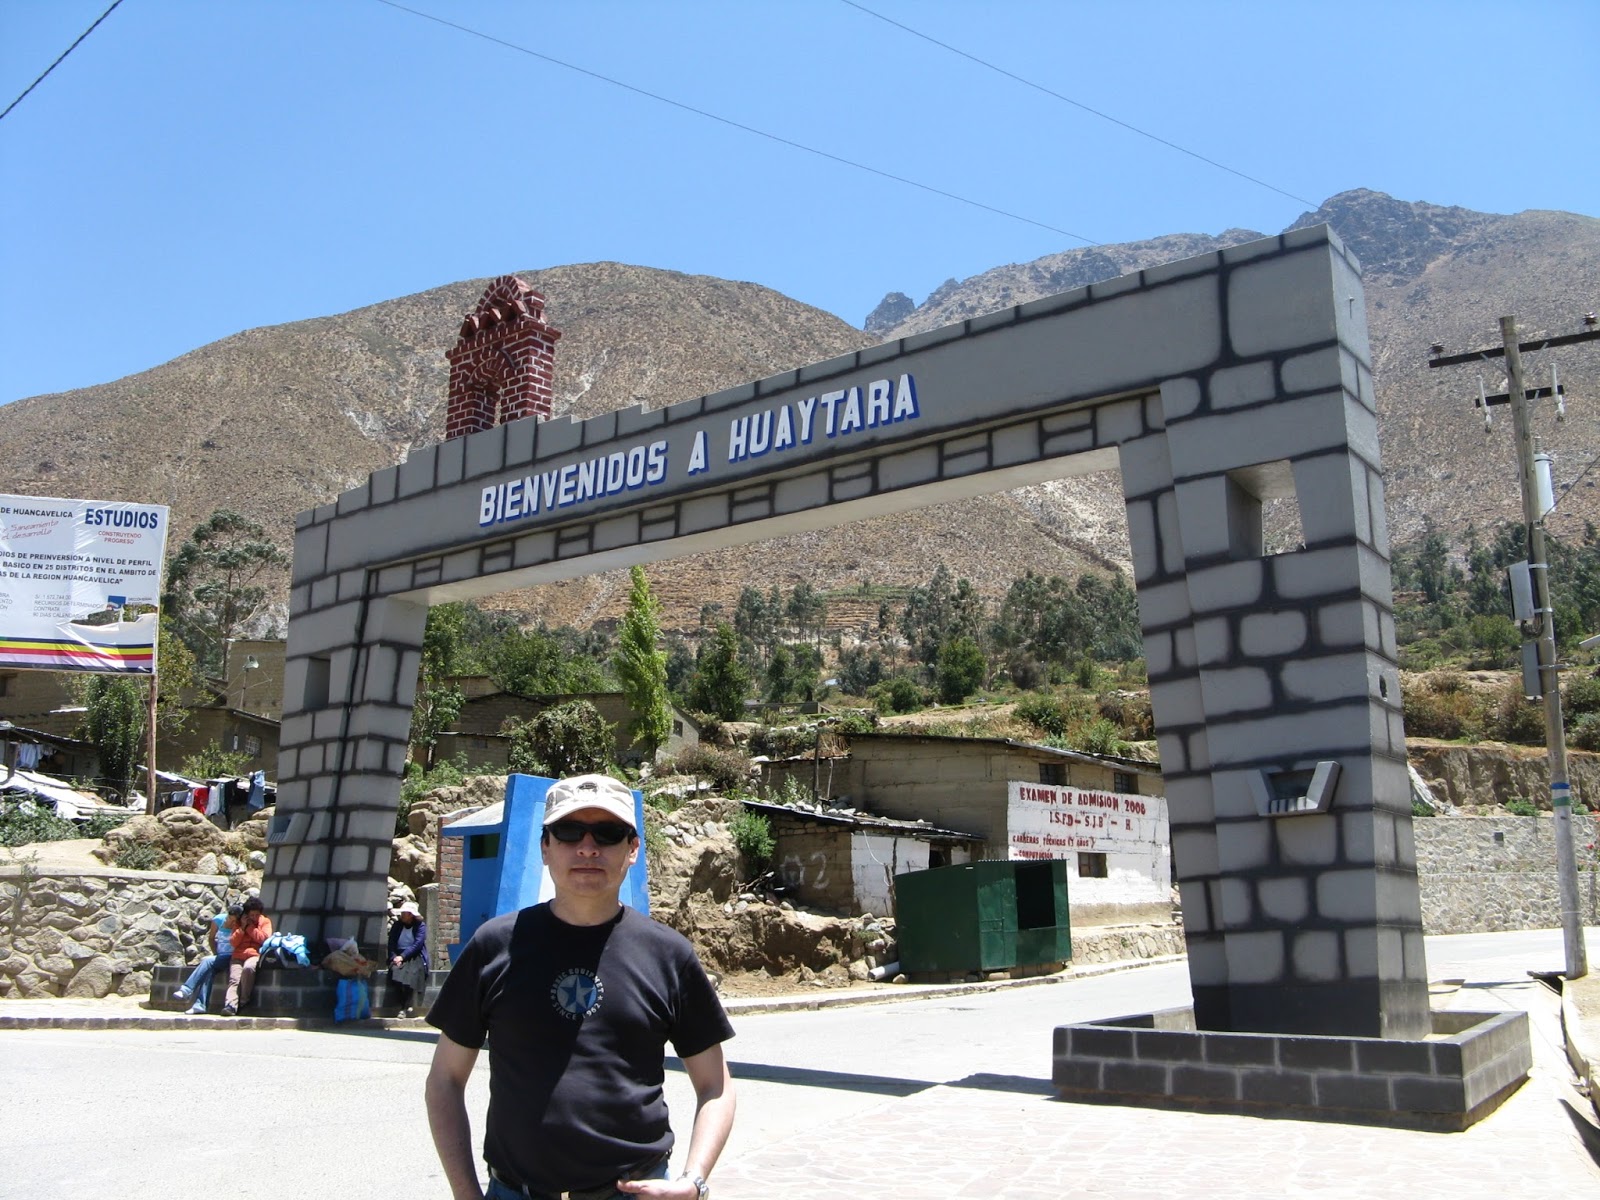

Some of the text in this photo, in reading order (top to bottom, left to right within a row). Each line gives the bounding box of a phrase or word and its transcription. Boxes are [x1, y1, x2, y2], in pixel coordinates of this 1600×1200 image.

[479, 373, 919, 527] BIENVENIDOS A HUAYTARA
[13, 508, 73, 518] HUANCAVELICA
[84, 508, 158, 530] ESTUDIOS
[3, 561, 31, 570] BASICO
[56, 565, 94, 573] DISTRITOS
[30, 553, 84, 562] PREINVERSION
[93, 557, 115, 565] NIVEL
[128, 559, 153, 567] PERFIL
[1019, 787, 1146, 815] EXAMEN DE ADMISION 2008
[1012, 834, 1039, 844] CARRERAS
[552, 1002, 601, 1020] SINCE 1962
